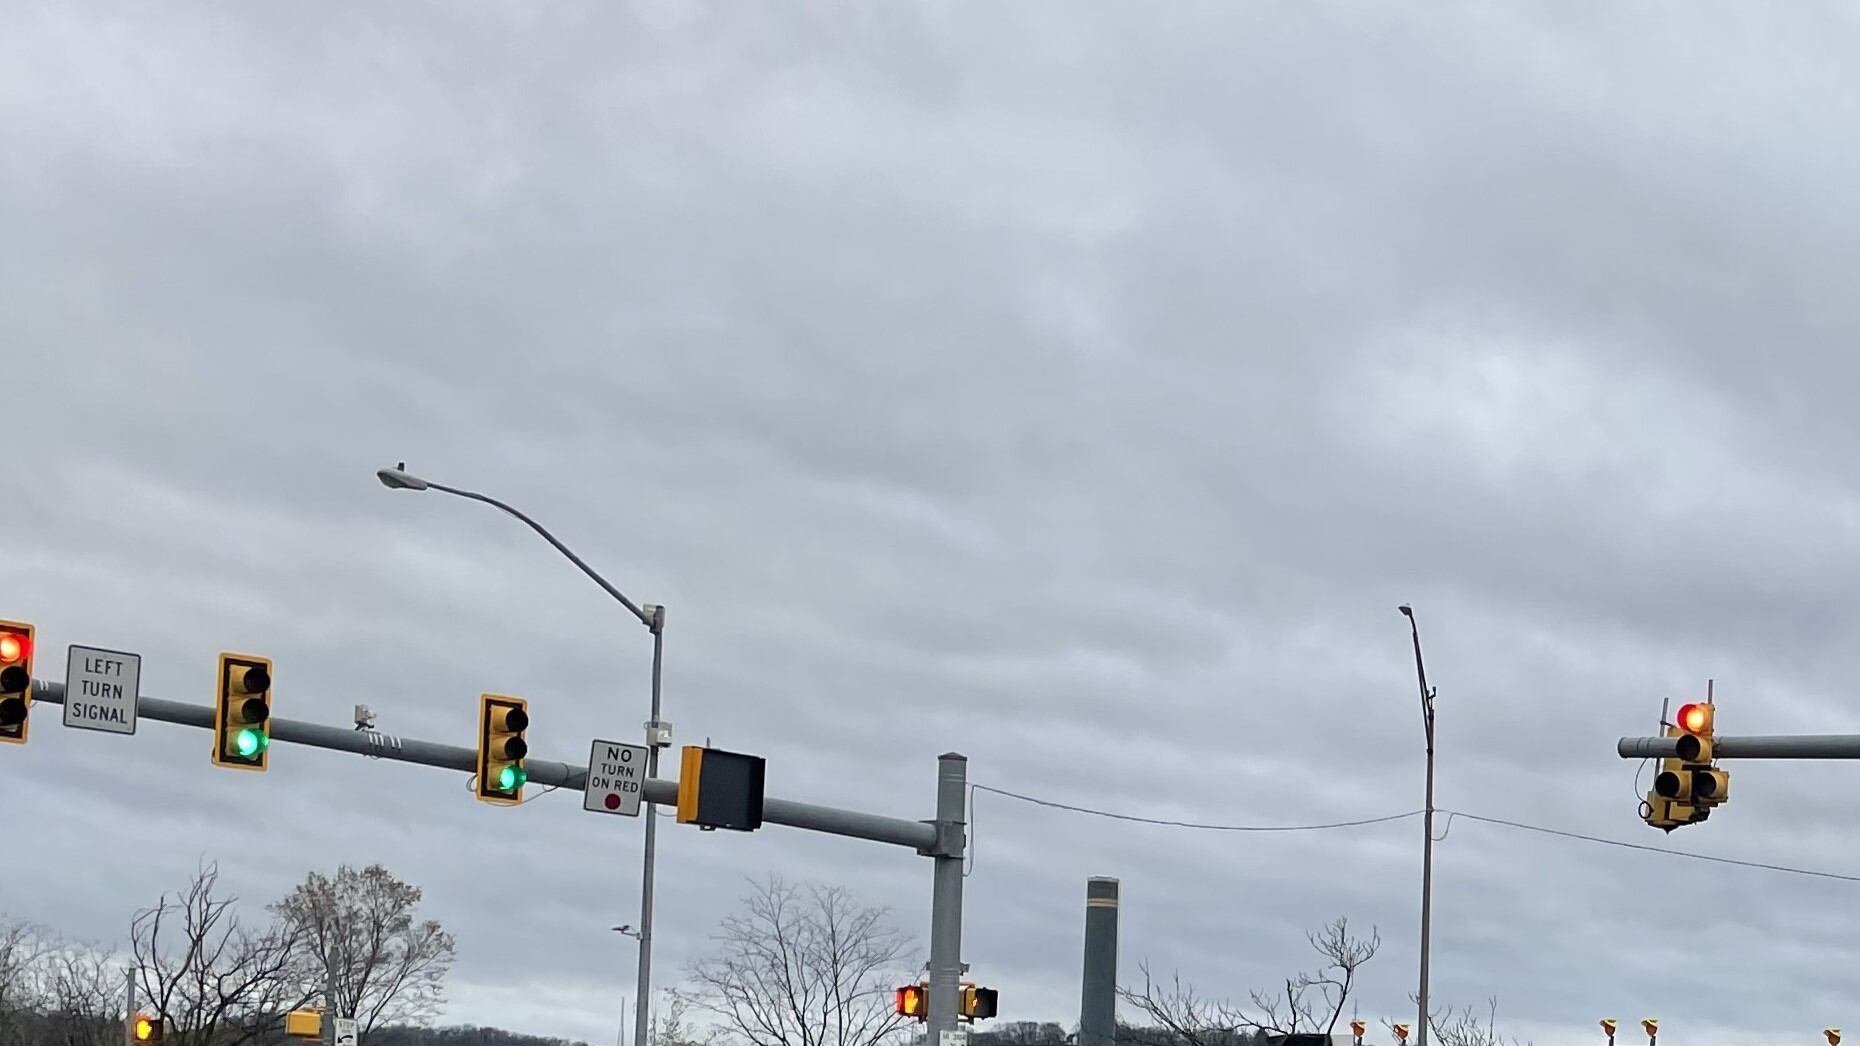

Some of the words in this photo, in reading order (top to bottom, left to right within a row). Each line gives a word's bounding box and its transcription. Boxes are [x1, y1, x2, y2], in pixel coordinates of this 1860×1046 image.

[85, 657, 123, 676] LEFT
[82, 680, 122, 699] TURN
[72, 702, 128, 724] SIGNAL
[607, 746, 632, 762] NO
[601, 763, 634, 778] TURN
[592, 776, 610, 789] ON
[614, 779, 638, 793] RED
